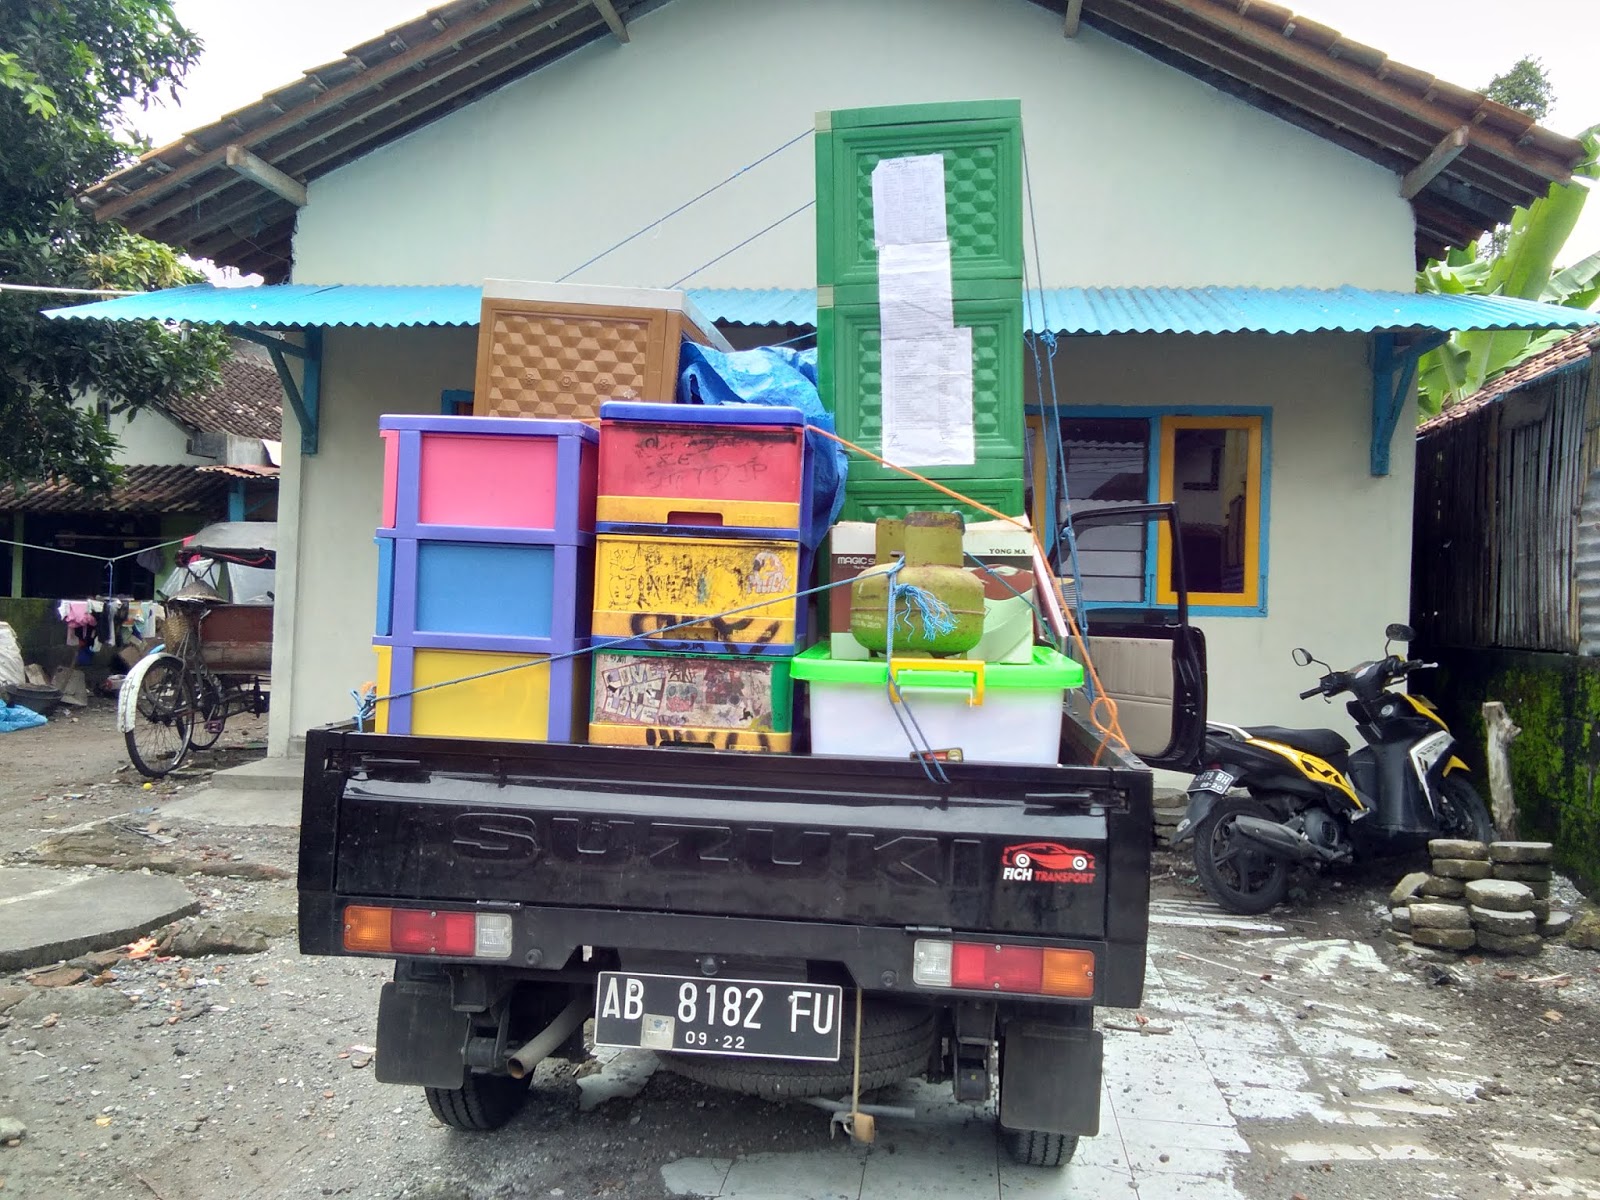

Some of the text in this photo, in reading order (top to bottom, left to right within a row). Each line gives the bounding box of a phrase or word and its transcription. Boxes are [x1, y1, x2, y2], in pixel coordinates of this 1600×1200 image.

[837, 556, 867, 565] MAGIC
[603, 662, 661, 688] LOVE
[604, 696, 659, 723] LOVE
[1216, 772, 1231, 785] BH
[452, 812, 984, 889] SUZUKI
[1002, 867, 1096, 883] FICH TRANSPORT
[602, 977, 835, 1035] AB 8182 FU
